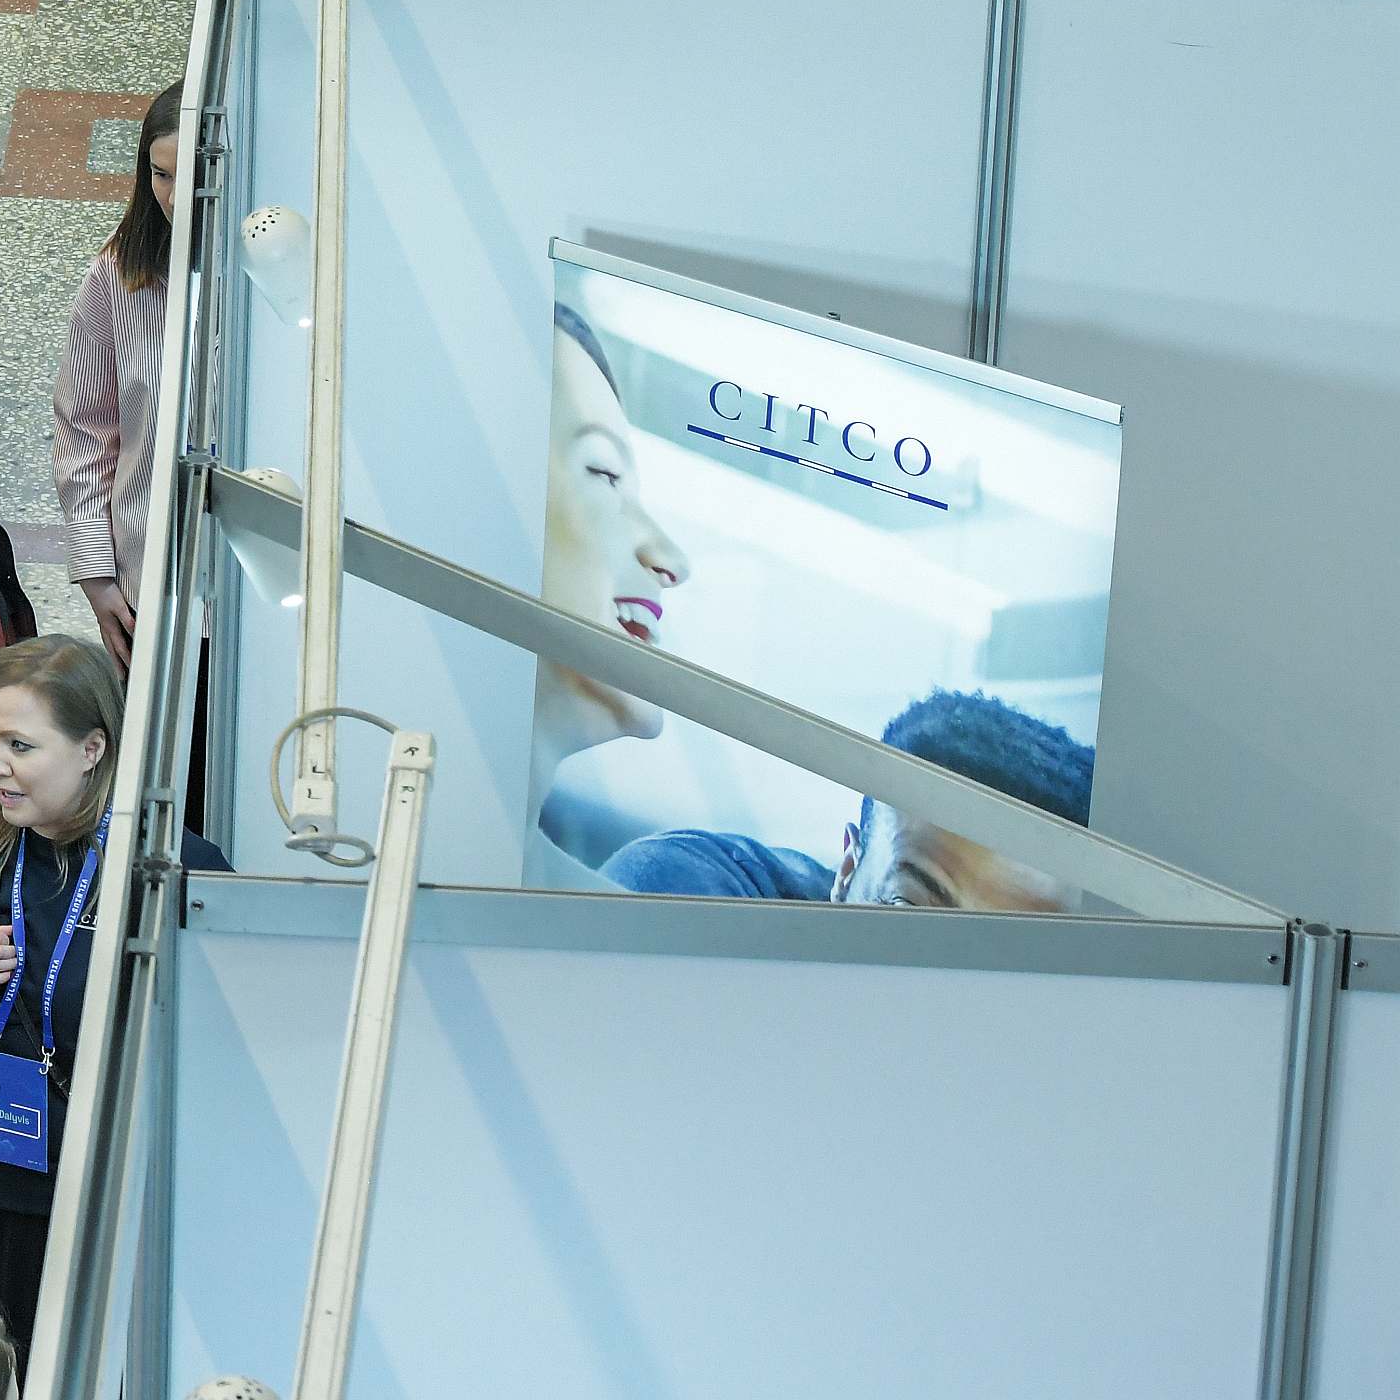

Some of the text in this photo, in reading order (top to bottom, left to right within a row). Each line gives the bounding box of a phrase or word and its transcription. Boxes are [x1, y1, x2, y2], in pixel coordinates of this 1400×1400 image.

[708, 380, 932, 477] CITCO
[13, 885, 22, 920] VILNIUS
[64, 879, 88, 934] VILNIUS TECH
[4, 946, 24, 1002] VILNIUS TECH
[43, 959, 60, 1017] VILNIUS TECH
